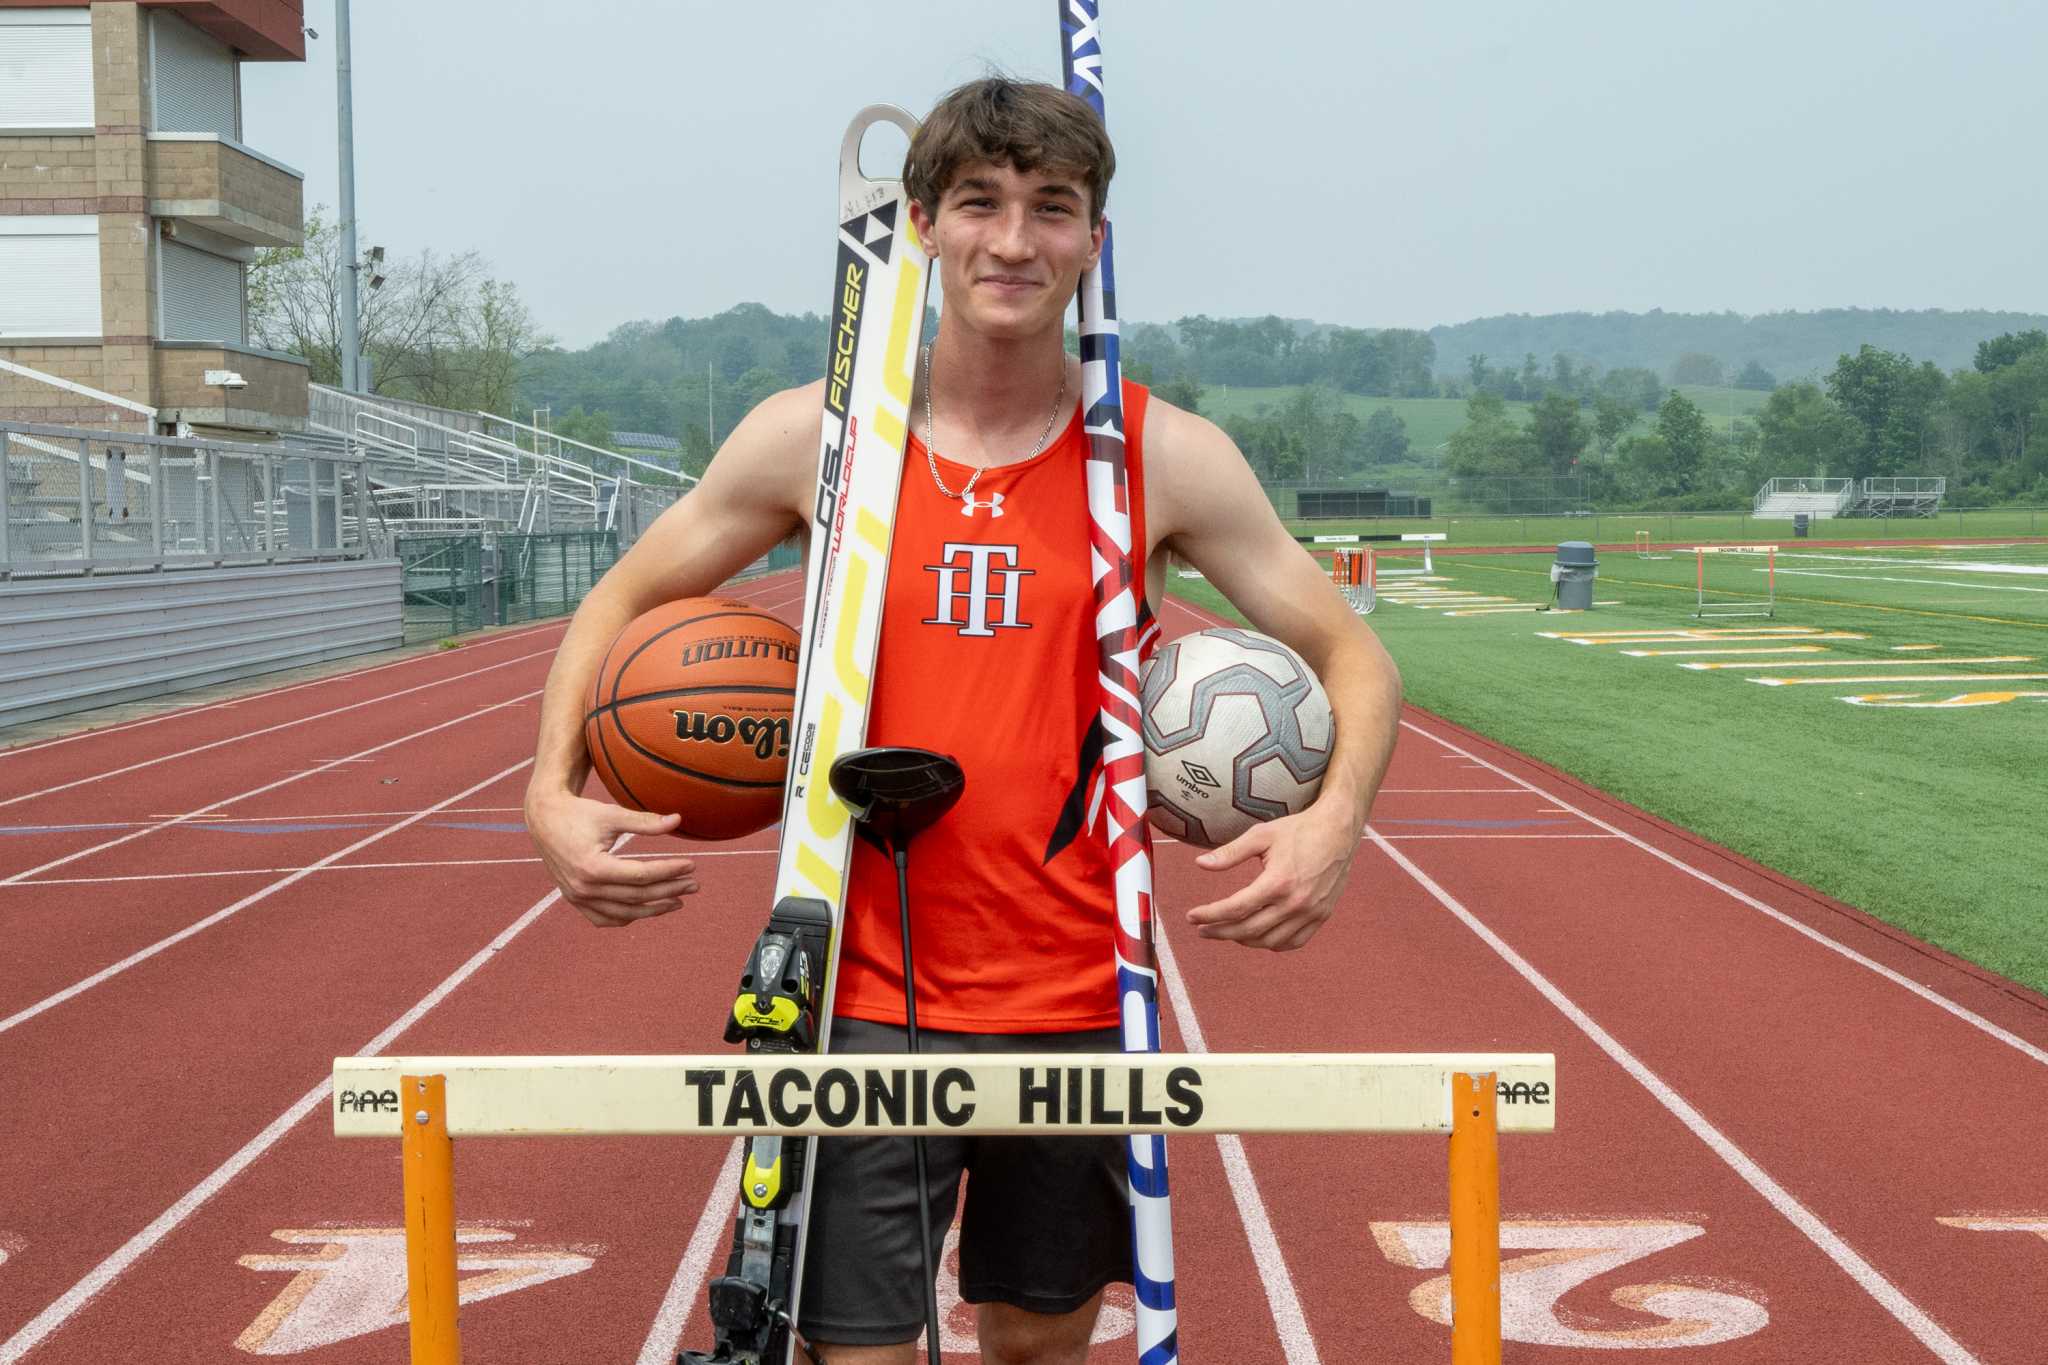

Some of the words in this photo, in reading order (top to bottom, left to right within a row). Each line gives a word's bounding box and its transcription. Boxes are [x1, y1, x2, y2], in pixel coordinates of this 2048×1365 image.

[829, 262, 865, 413] FISCHER
[816, 443, 841, 528] GS
[672, 709, 791, 761] ilson
[1176, 774, 1210, 799] umbro
[685, 1067, 975, 1128] TACONIC
[1018, 1067, 1204, 1128] HILLS
